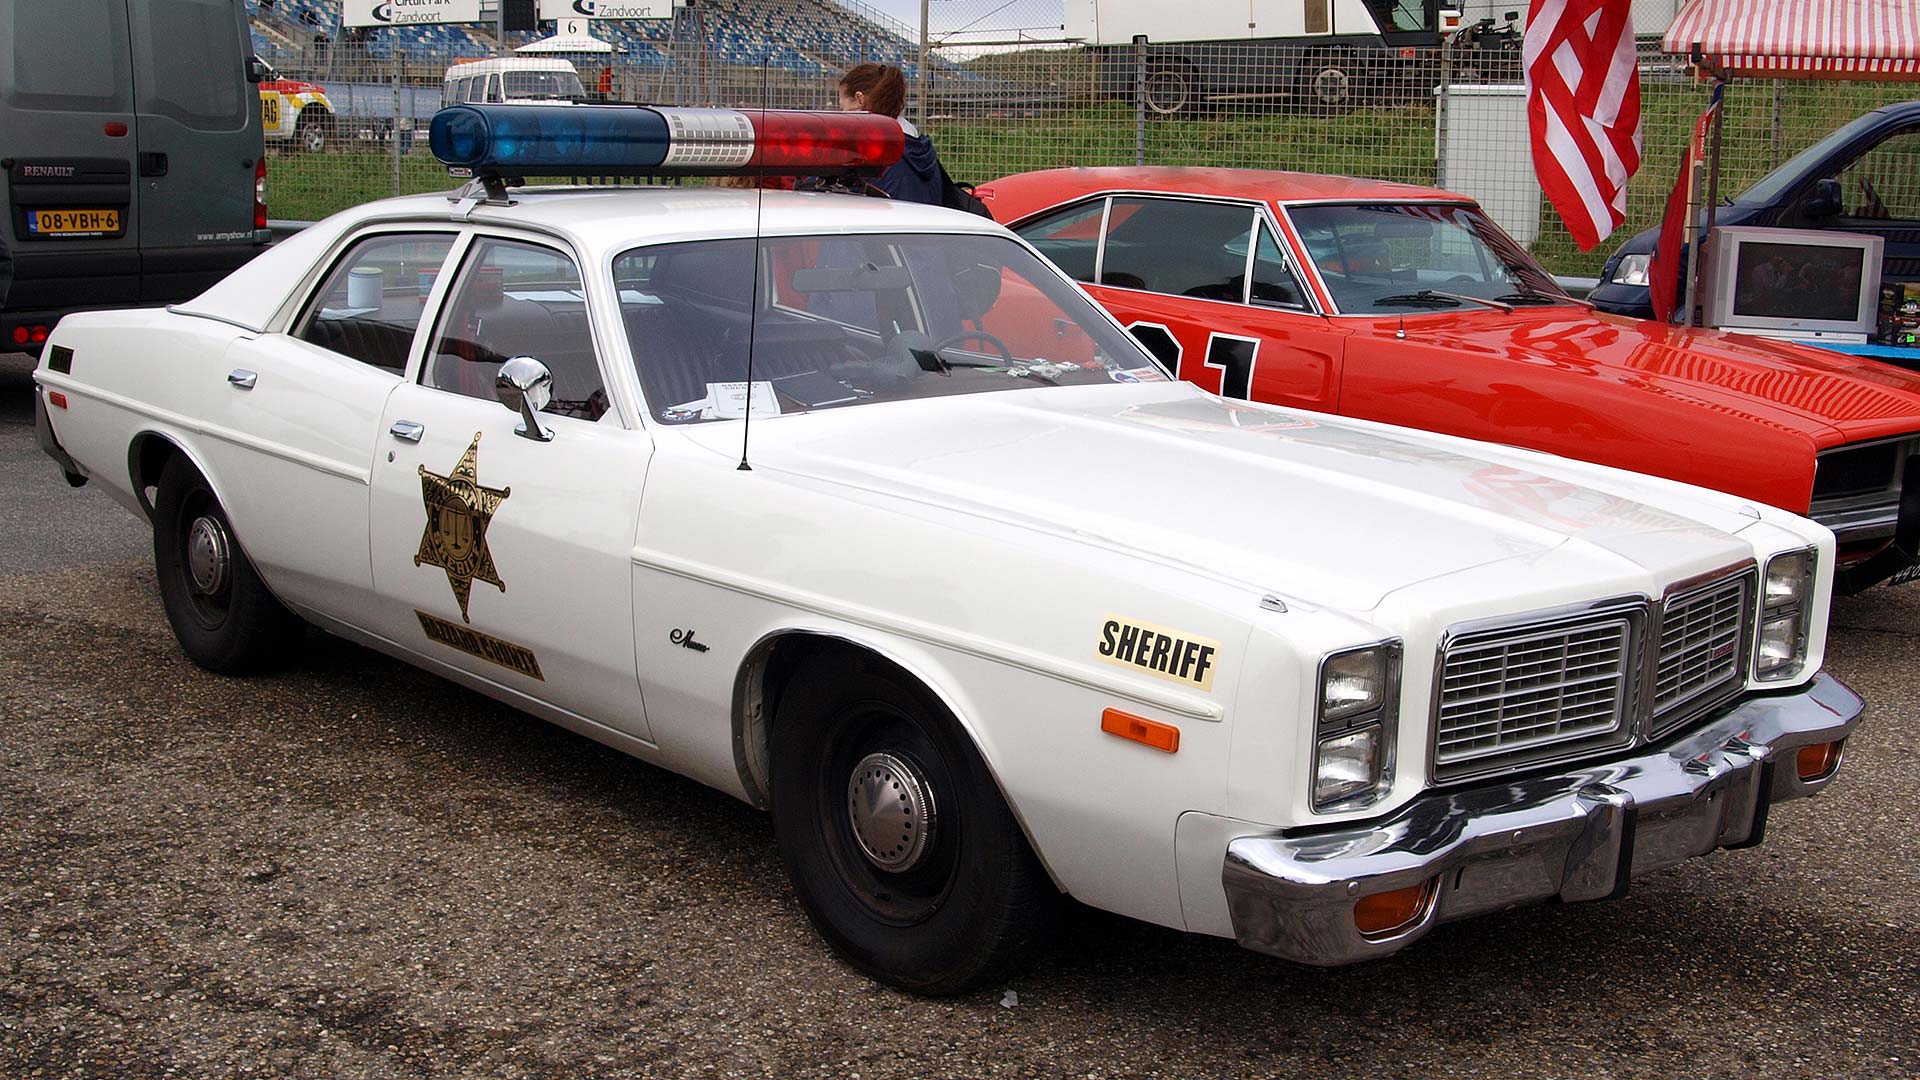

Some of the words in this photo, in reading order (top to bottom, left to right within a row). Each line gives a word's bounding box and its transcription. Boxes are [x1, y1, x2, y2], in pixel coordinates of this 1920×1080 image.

[395, 11, 441, 23] Zandvoort
[600, 4, 652, 17] Zandvoort
[567, 20, 577, 34] 6
[24, 166, 75, 176] RENAULT
[41, 213, 115, 229] 08-VBH-6
[1099, 620, 1215, 682] SHERIFF
